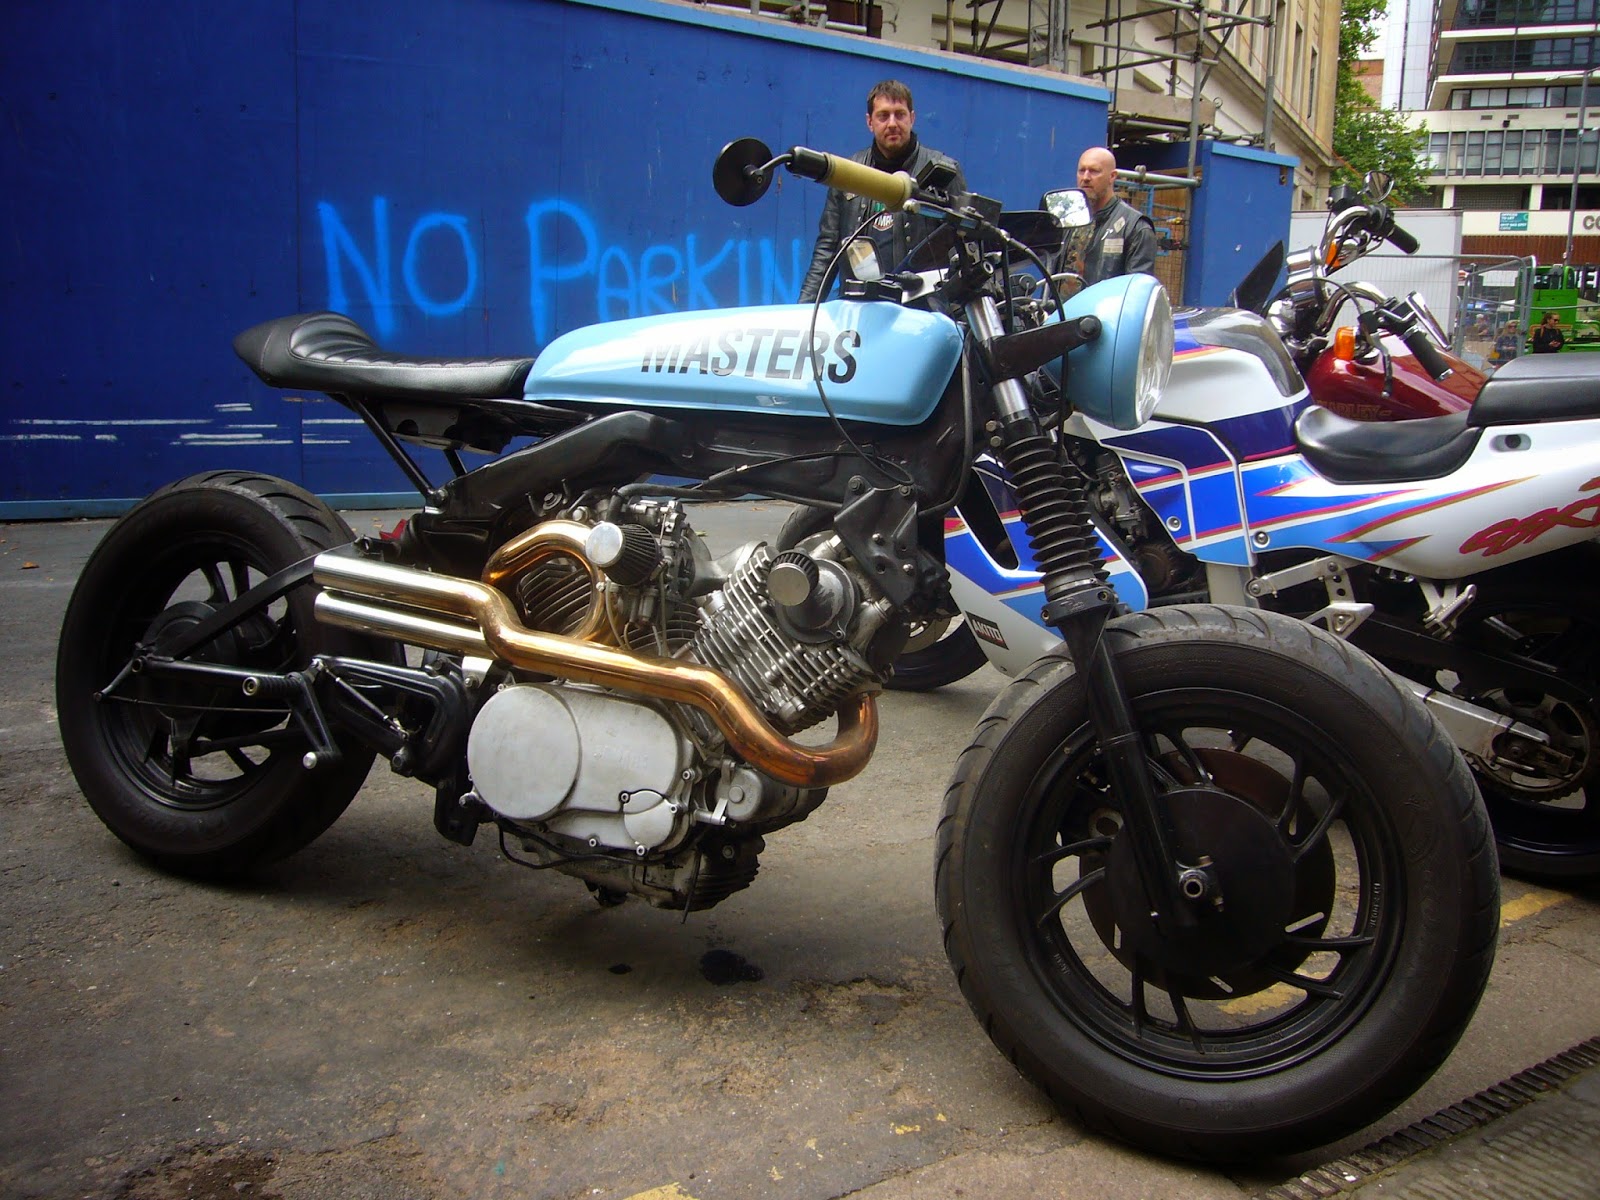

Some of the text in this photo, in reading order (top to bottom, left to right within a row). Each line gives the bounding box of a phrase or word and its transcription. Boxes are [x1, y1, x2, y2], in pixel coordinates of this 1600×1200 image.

[318, 195, 840, 345] NO PARKIN
[641, 328, 861, 384] MASTERS
